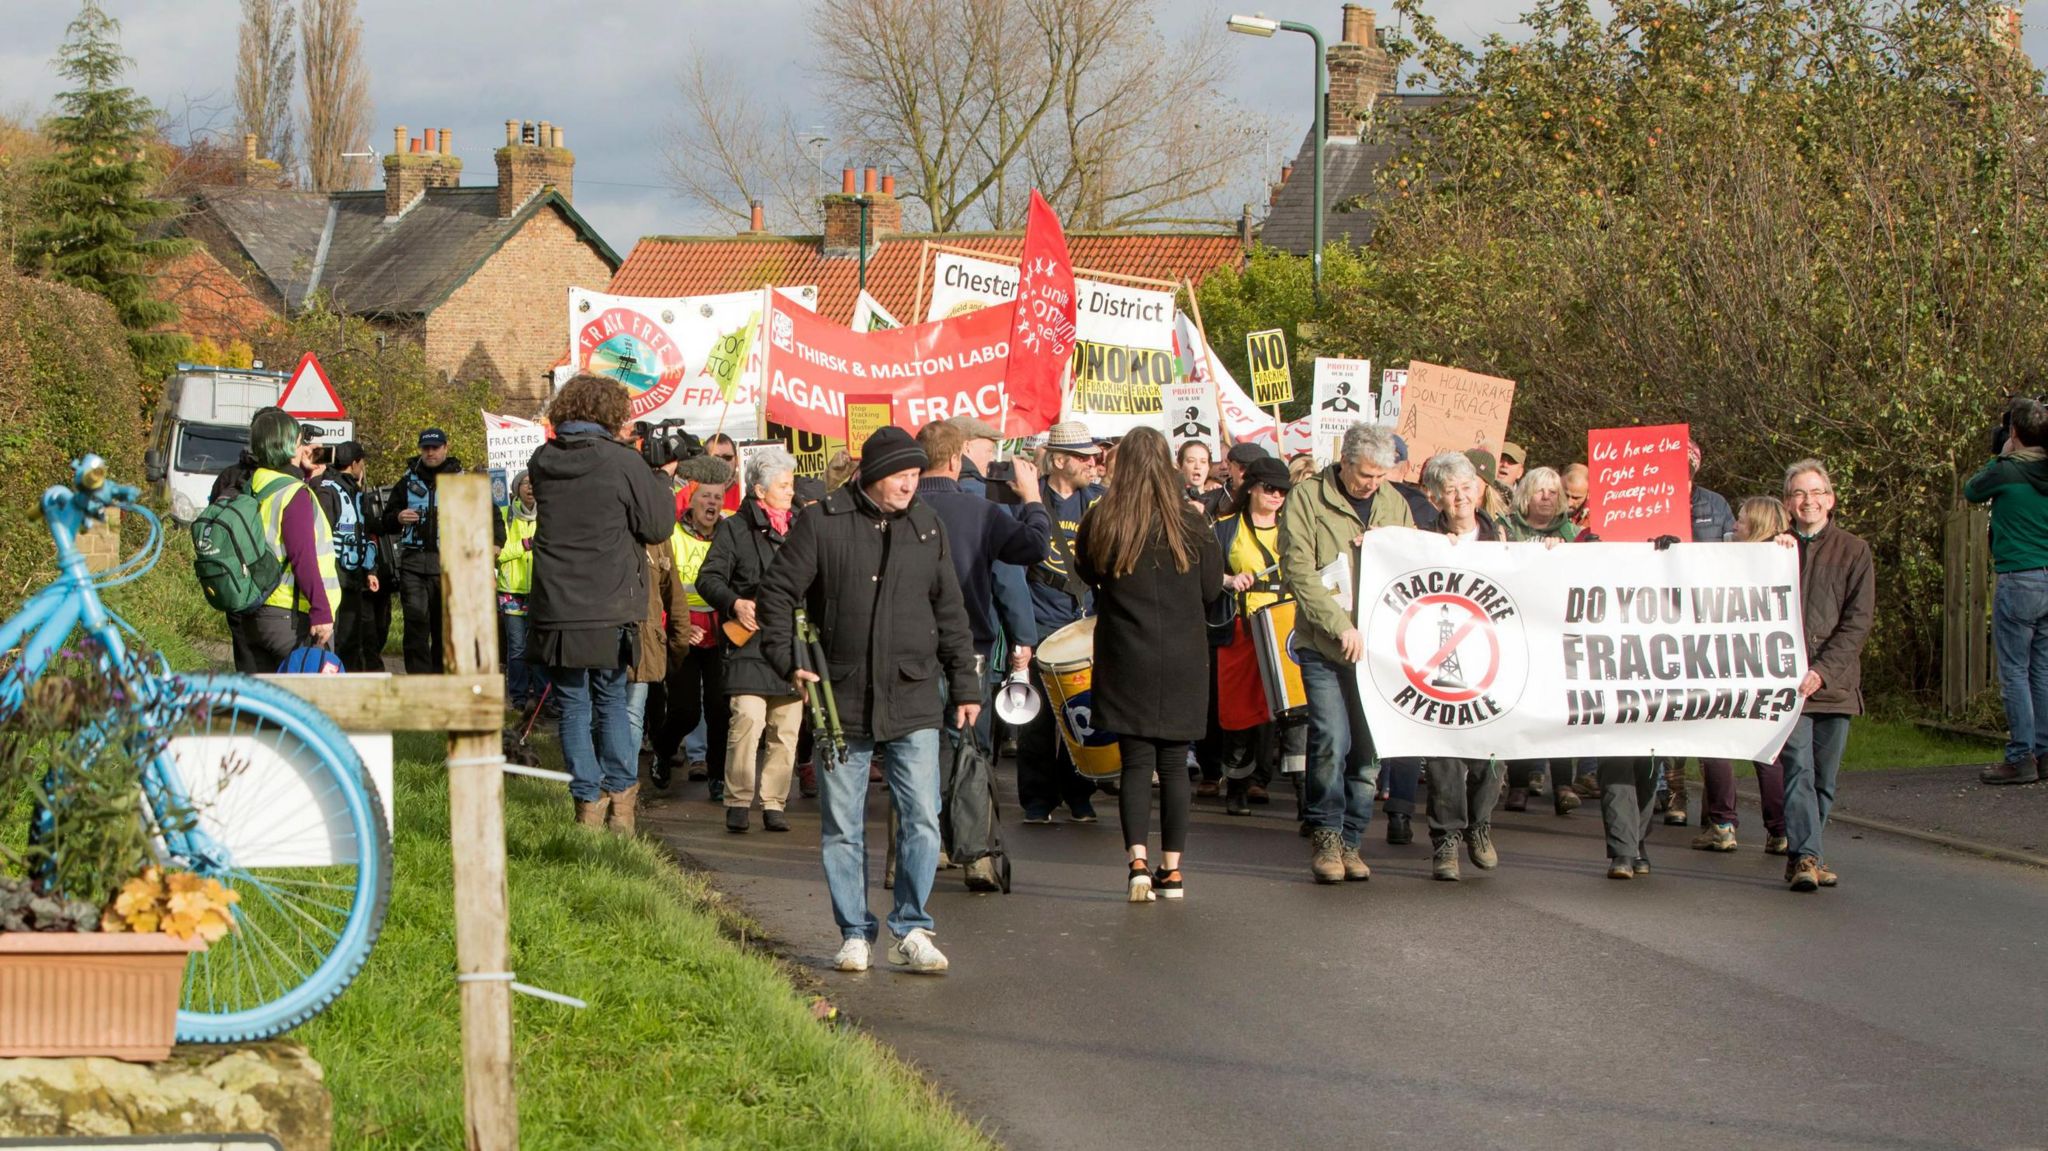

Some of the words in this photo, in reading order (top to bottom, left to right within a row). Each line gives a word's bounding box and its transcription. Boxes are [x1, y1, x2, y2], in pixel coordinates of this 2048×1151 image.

[945, 264, 1019, 298] Chester
[1090, 291, 1164, 323] District
[632, 316, 673, 354] FREE
[796, 341, 849, 375] THIRSK
[852, 362, 867, 378] &
[871, 356, 954, 380] MALTON
[958, 341, 1010, 370] LABO
[1088, 344, 1126, 383] NO
[1250, 334, 1285, 373] NO
[1130, 350, 1173, 385] NO
[1254, 369, 1287, 385] FRACKING
[1087, 380, 1128, 395] FRACKING
[1131, 386, 1161, 396] FRACK
[1256, 380, 1290, 403] WAY!
[1440, 372, 1513, 403] HOLLINRAKE
[1087, 392, 1130, 412] WAY!
[1133, 396, 1163, 412] WA
[1453, 393, 1501, 420] FRACK
[489, 435, 540, 446] FRACKERS
[518, 448, 534, 458] PIS
[1593, 441, 1618, 461] We
[1623, 440, 1654, 458] have
[1658, 438, 1681, 452] the
[505, 460, 517, 469] MY
[794, 453, 824, 474] KING
[1600, 466, 1635, 487] right
[1643, 463, 1659, 477] to
[1603, 482, 1675, 506] peacefully
[1603, 498, 1670, 527] protest!
[1382, 571, 1465, 615] FRACK
[1464, 577, 1515, 624] FREE
[1565, 586, 1607, 624] DO
[1616, 586, 1682, 625] YOU
[1691, 585, 1792, 624] WANT
[1562, 630, 1798, 681] FRACKING
[1392, 685, 1502, 726] RYEDALE
[1566, 689, 1606, 726] IN
[1615, 687, 1798, 725] RYEDALE?
